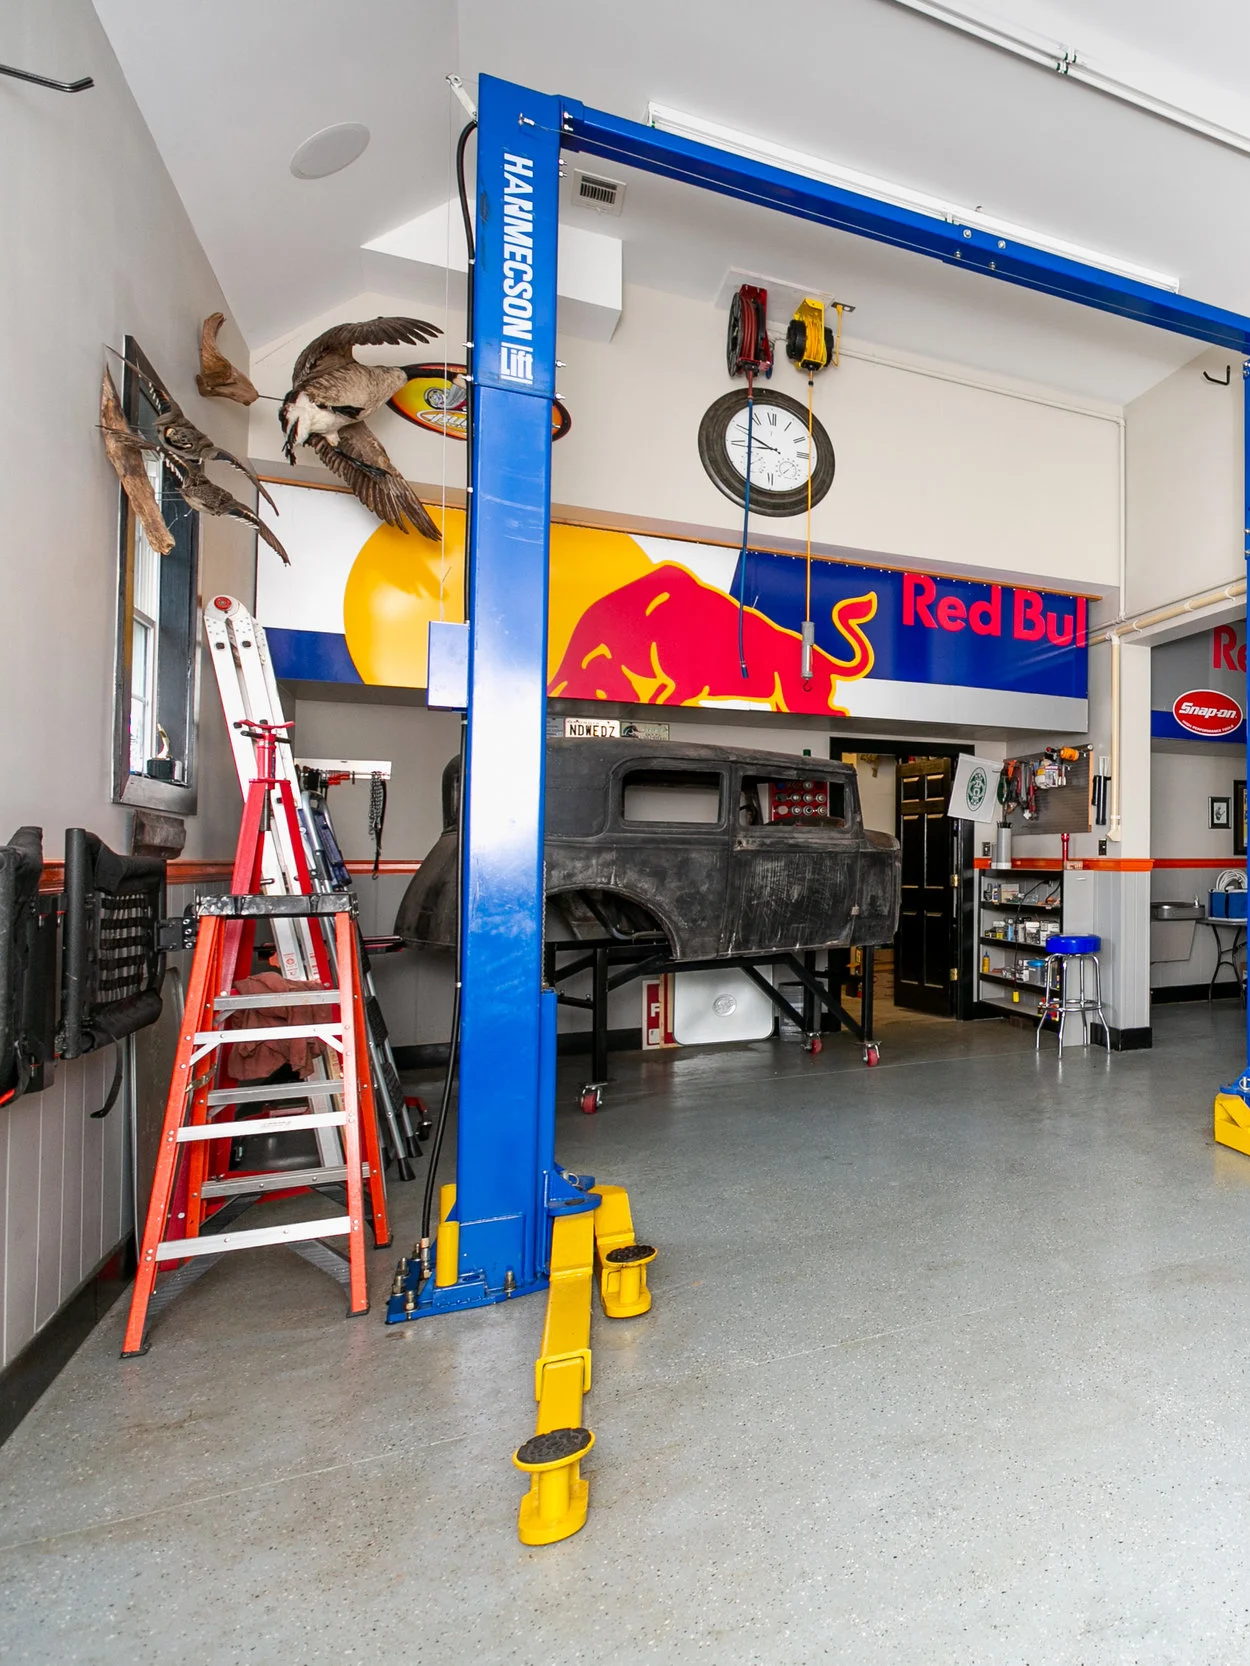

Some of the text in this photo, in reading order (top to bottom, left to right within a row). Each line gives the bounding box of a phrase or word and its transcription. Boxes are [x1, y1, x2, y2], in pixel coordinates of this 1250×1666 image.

[502, 152, 534, 341] HANMECSON
[501, 344, 534, 382] Lift
[902, 572, 1002, 637] Red
[1178, 701, 1238, 719] Snap-on
